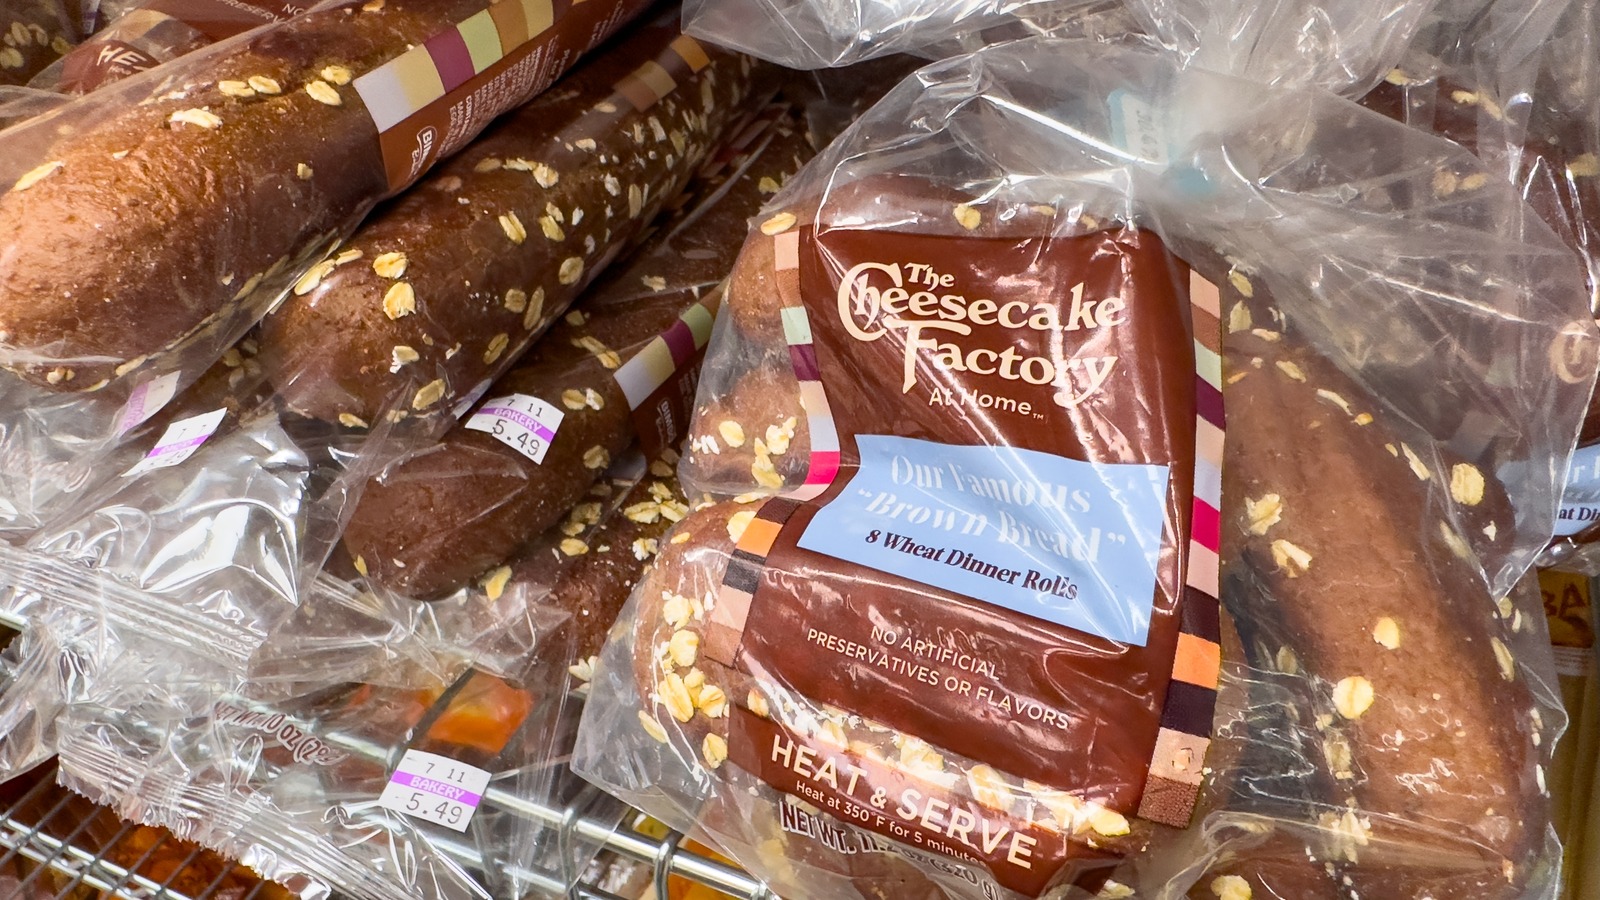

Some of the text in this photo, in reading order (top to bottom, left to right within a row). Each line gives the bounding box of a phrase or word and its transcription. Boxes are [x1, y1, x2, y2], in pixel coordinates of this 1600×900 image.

[904, 262, 955, 291] The
[837, 262, 1126, 341] Cheesecake
[883, 315, 1118, 407] Factory
[527, 403, 543, 417] 11
[929, 389, 952, 406] At
[492, 419, 540, 456] 5.49
[494, 408, 542, 432] BAKERY
[891, 454, 1091, 513] Our Famous
[865, 529, 1078, 600] 8 Wheat Dinner Rolls
[871, 625, 1000, 681] NO ARTIFICIAL
[806, 628, 1070, 730] PRESERVATIVES OR FLAVORS
[277, 723, 303, 751] OZ
[410, 776, 465, 800] BAKERY
[426, 762, 465, 783] 7 11
[406, 792, 463, 825] 5.49
[771, 734, 1037, 870] HEAT & SERVE
[779, 801, 815, 838] NET
[796, 780, 824, 802] Heat
[827, 796, 841, 811] at
[889, 820, 910, 838] for
[914, 831, 923, 844] 5
